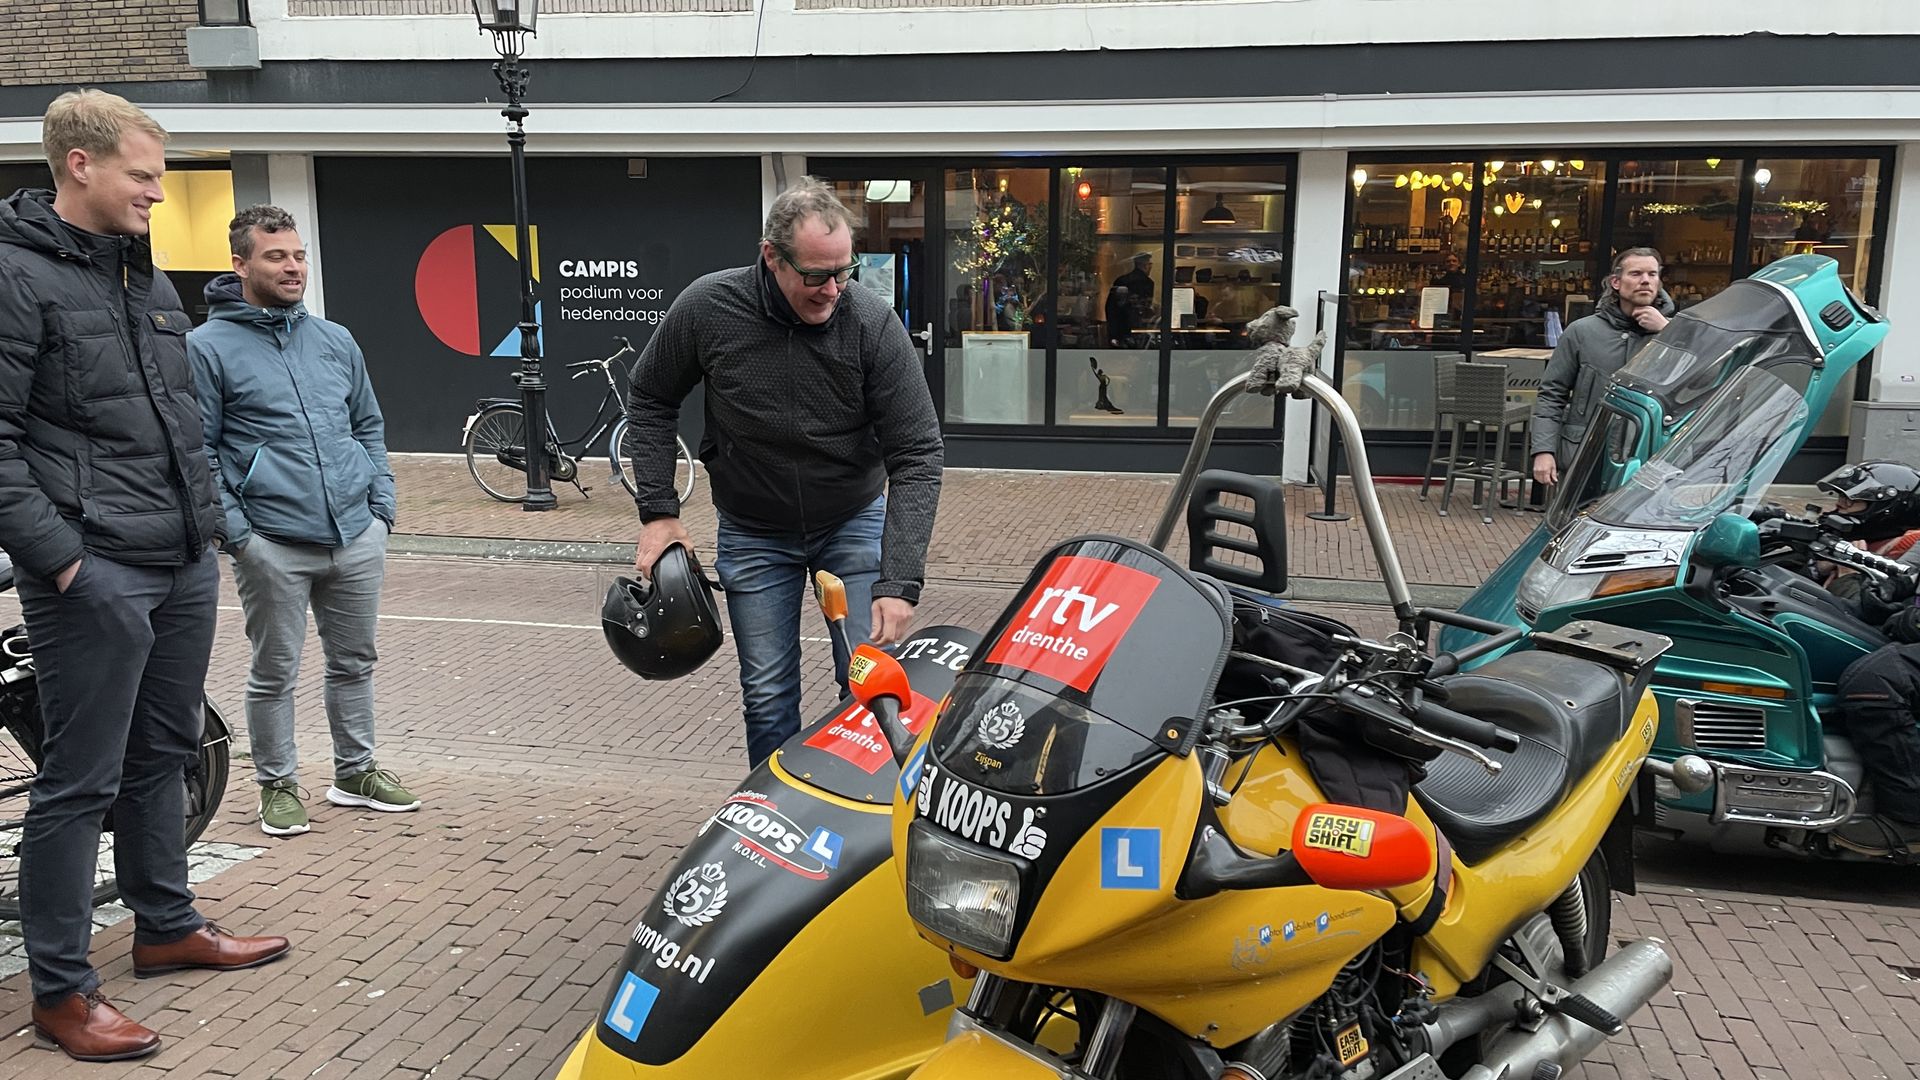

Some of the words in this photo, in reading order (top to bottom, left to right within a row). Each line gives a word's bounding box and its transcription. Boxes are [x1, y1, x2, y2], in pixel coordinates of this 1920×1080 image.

[559, 260, 639, 278] CAMPIS
[560, 285, 622, 302] podium
[627, 288, 664, 300] voor
[1028, 586, 1120, 633] rtv
[1011, 625, 1089, 661] drenthe
[827, 724, 883, 753] drenthe
[987, 715, 1014, 741] 25
[974, 751, 1002, 769] Zijspan
[934, 777, 1012, 848] KOOPS
[1312, 815, 1360, 833] EASY
[720, 803, 802, 854] KOOPS
[731, 841, 767, 869] N.O.V.L.
[812, 829, 834, 860] L
[1117, 838, 1143, 877] L
[676, 878, 712, 913] 25
[611, 981, 636, 1033] L
